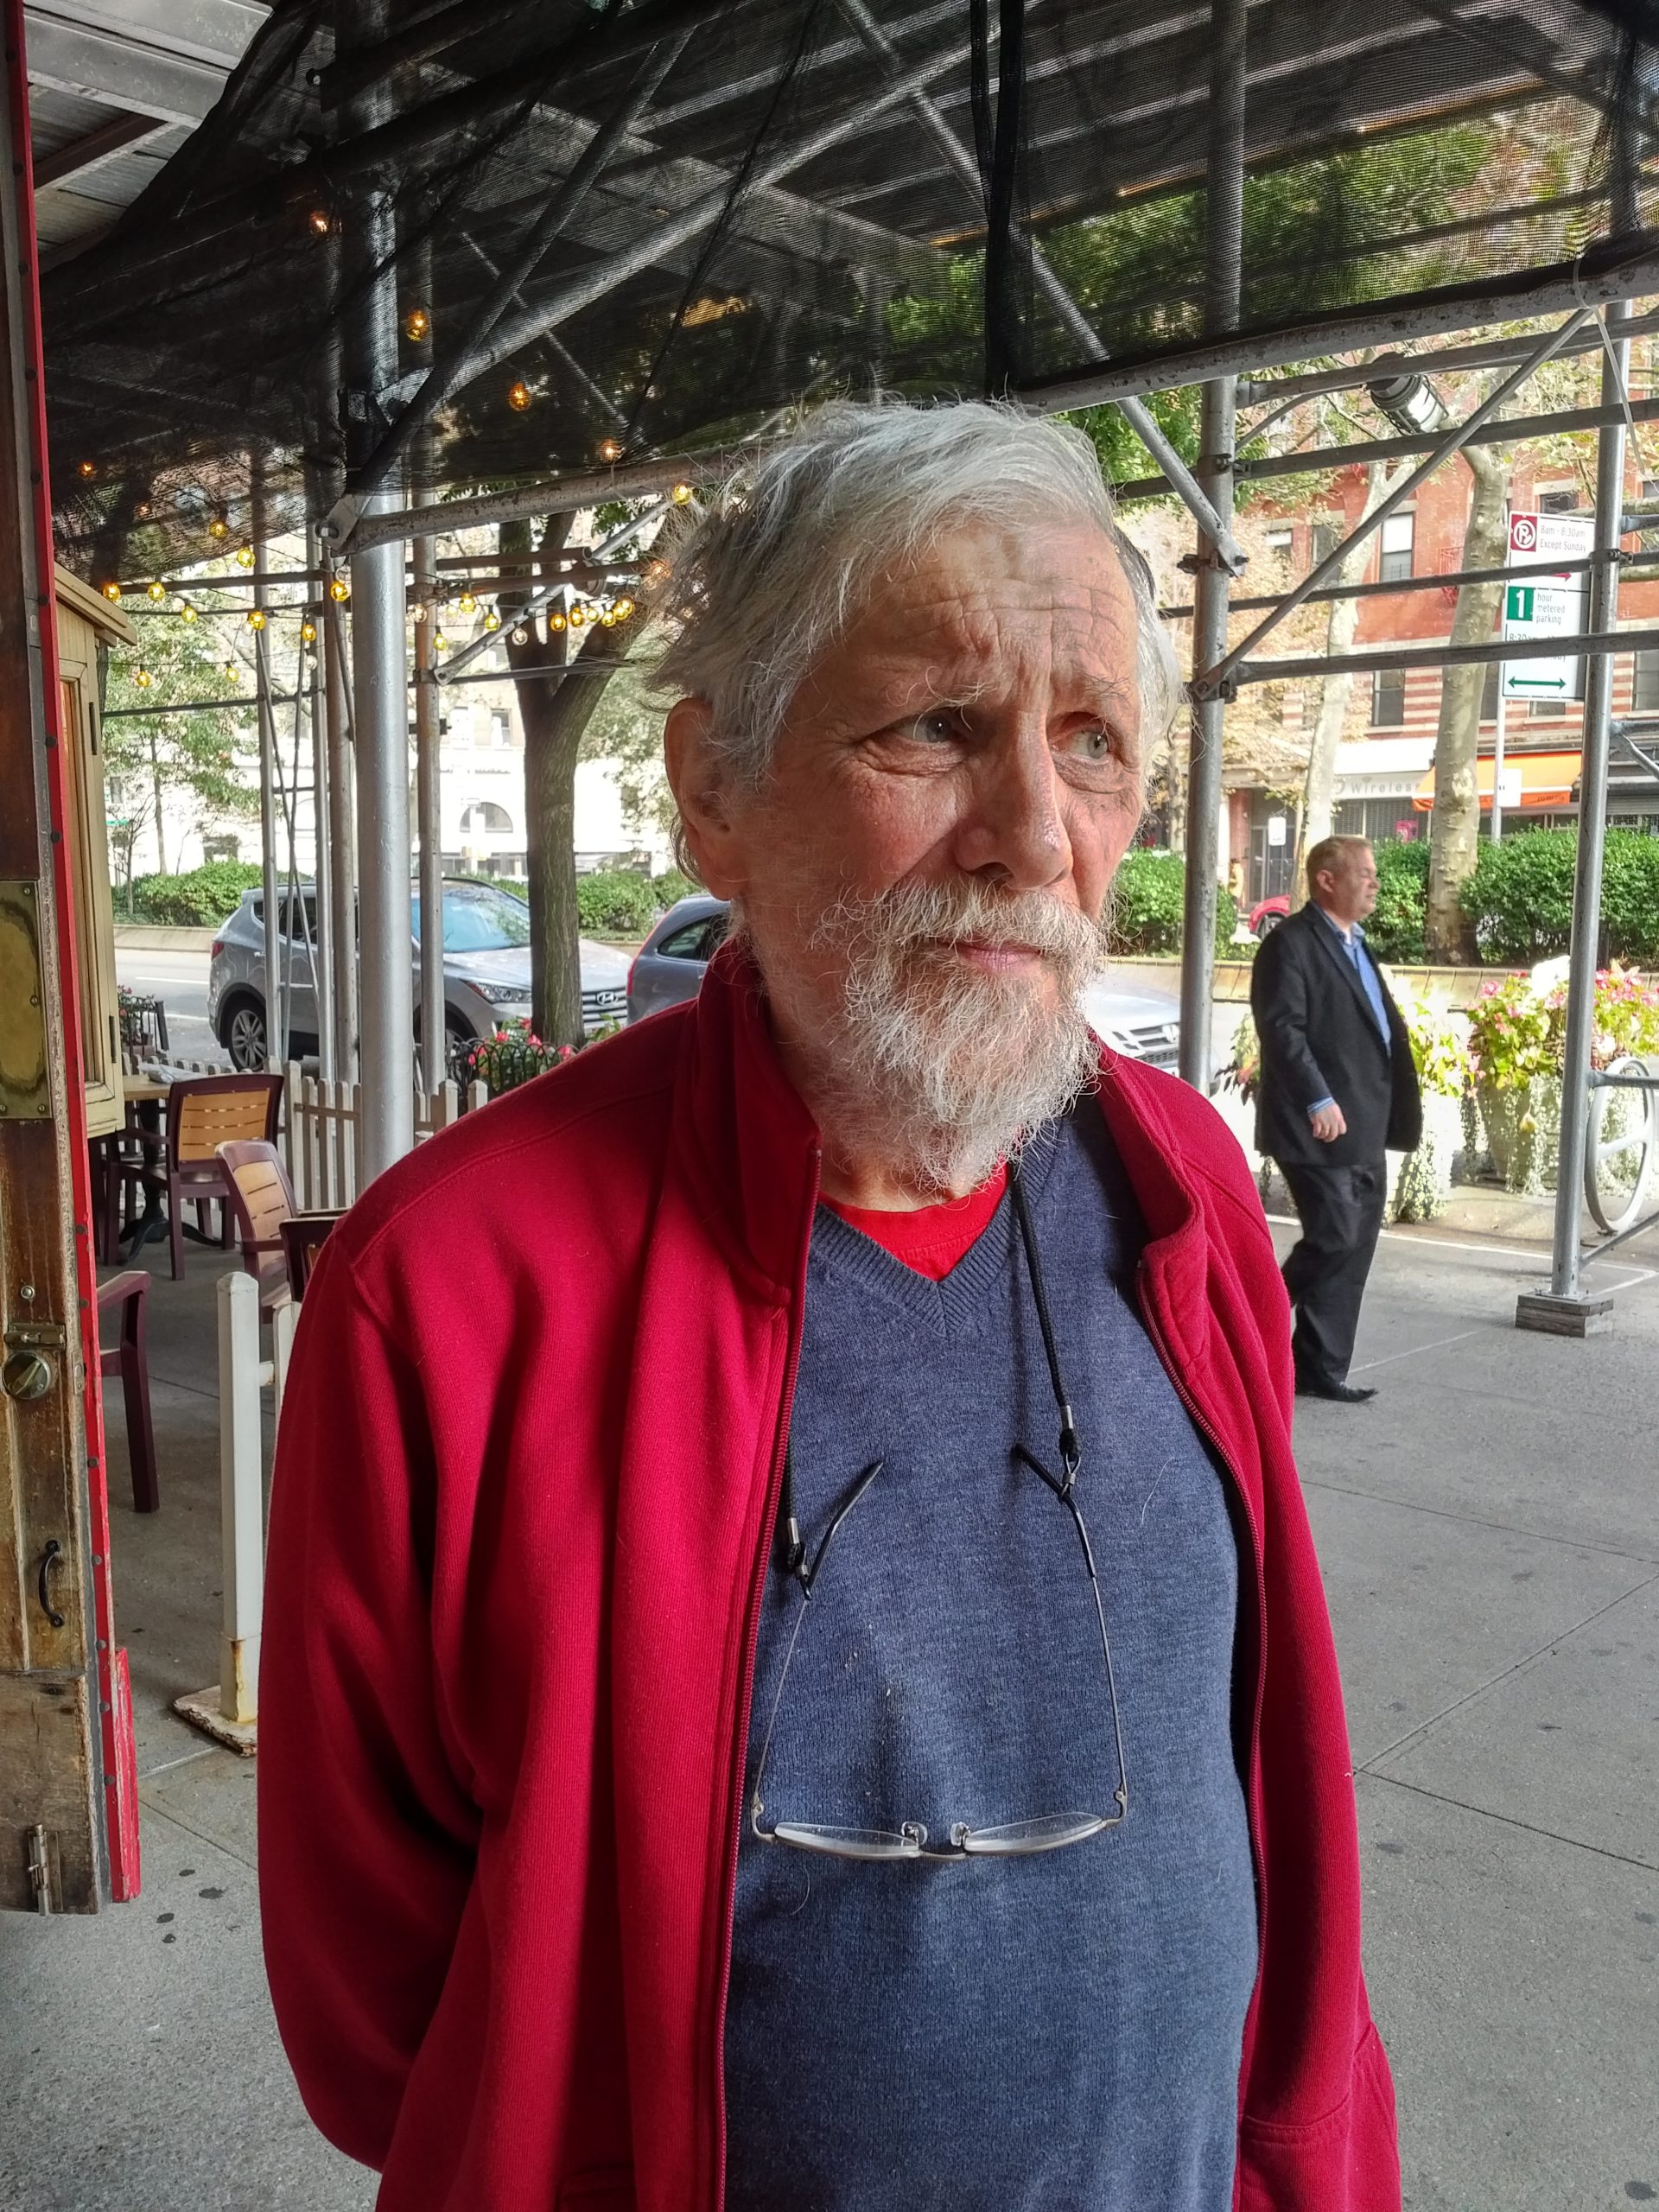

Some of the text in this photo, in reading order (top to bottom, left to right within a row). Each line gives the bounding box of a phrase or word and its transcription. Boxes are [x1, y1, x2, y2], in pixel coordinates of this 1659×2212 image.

[1541, 525, 1555, 536] 8am
[1560, 528, 1586, 537] 8:30am
[1540, 540, 1586, 553] Except Sunday
[1537, 593, 1553, 602] hour
[1516, 589, 1525, 619] 1
[1536, 604, 1566, 613] metered
[1536, 614, 1561, 626] parking
